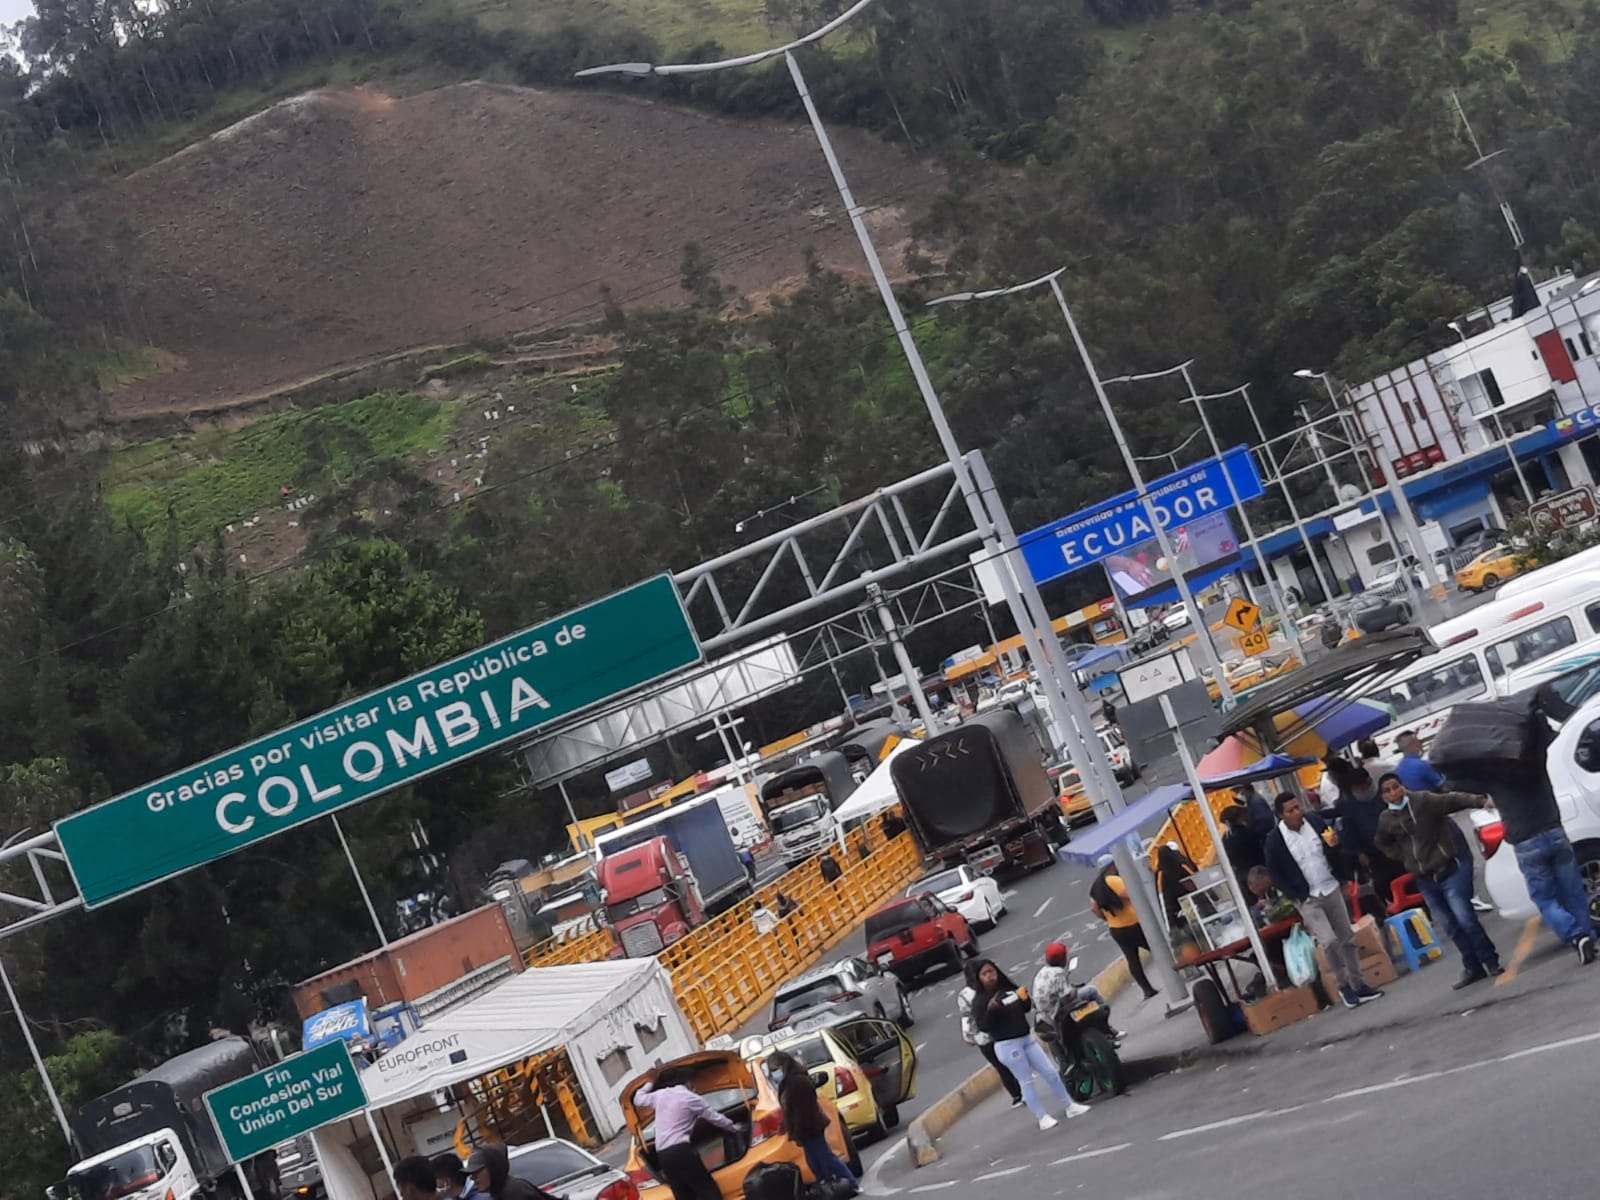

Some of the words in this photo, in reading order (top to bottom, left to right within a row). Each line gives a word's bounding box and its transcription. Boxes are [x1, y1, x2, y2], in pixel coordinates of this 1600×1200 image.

[1060, 486, 1218, 565] ECUADOR
[1244, 633, 1263, 648] 40
[146, 763, 244, 812] Gracias
[250, 742, 292, 776] por
[300, 706, 380, 750] visitar
[387, 695, 414, 715] la
[417, 639, 548, 703] República
[555, 624, 587, 646] de
[215, 676, 552, 834] COLOMBIA
[264, 1069, 292, 1088] Fin
[377, 1033, 460, 1073] EUROFRONT
[229, 1079, 312, 1120] Concesion
[312, 1062, 343, 1084] Vial
[239, 1108, 286, 1135] Unión
[287, 1093, 315, 1115] Del
[316, 1082, 343, 1101] Sur
